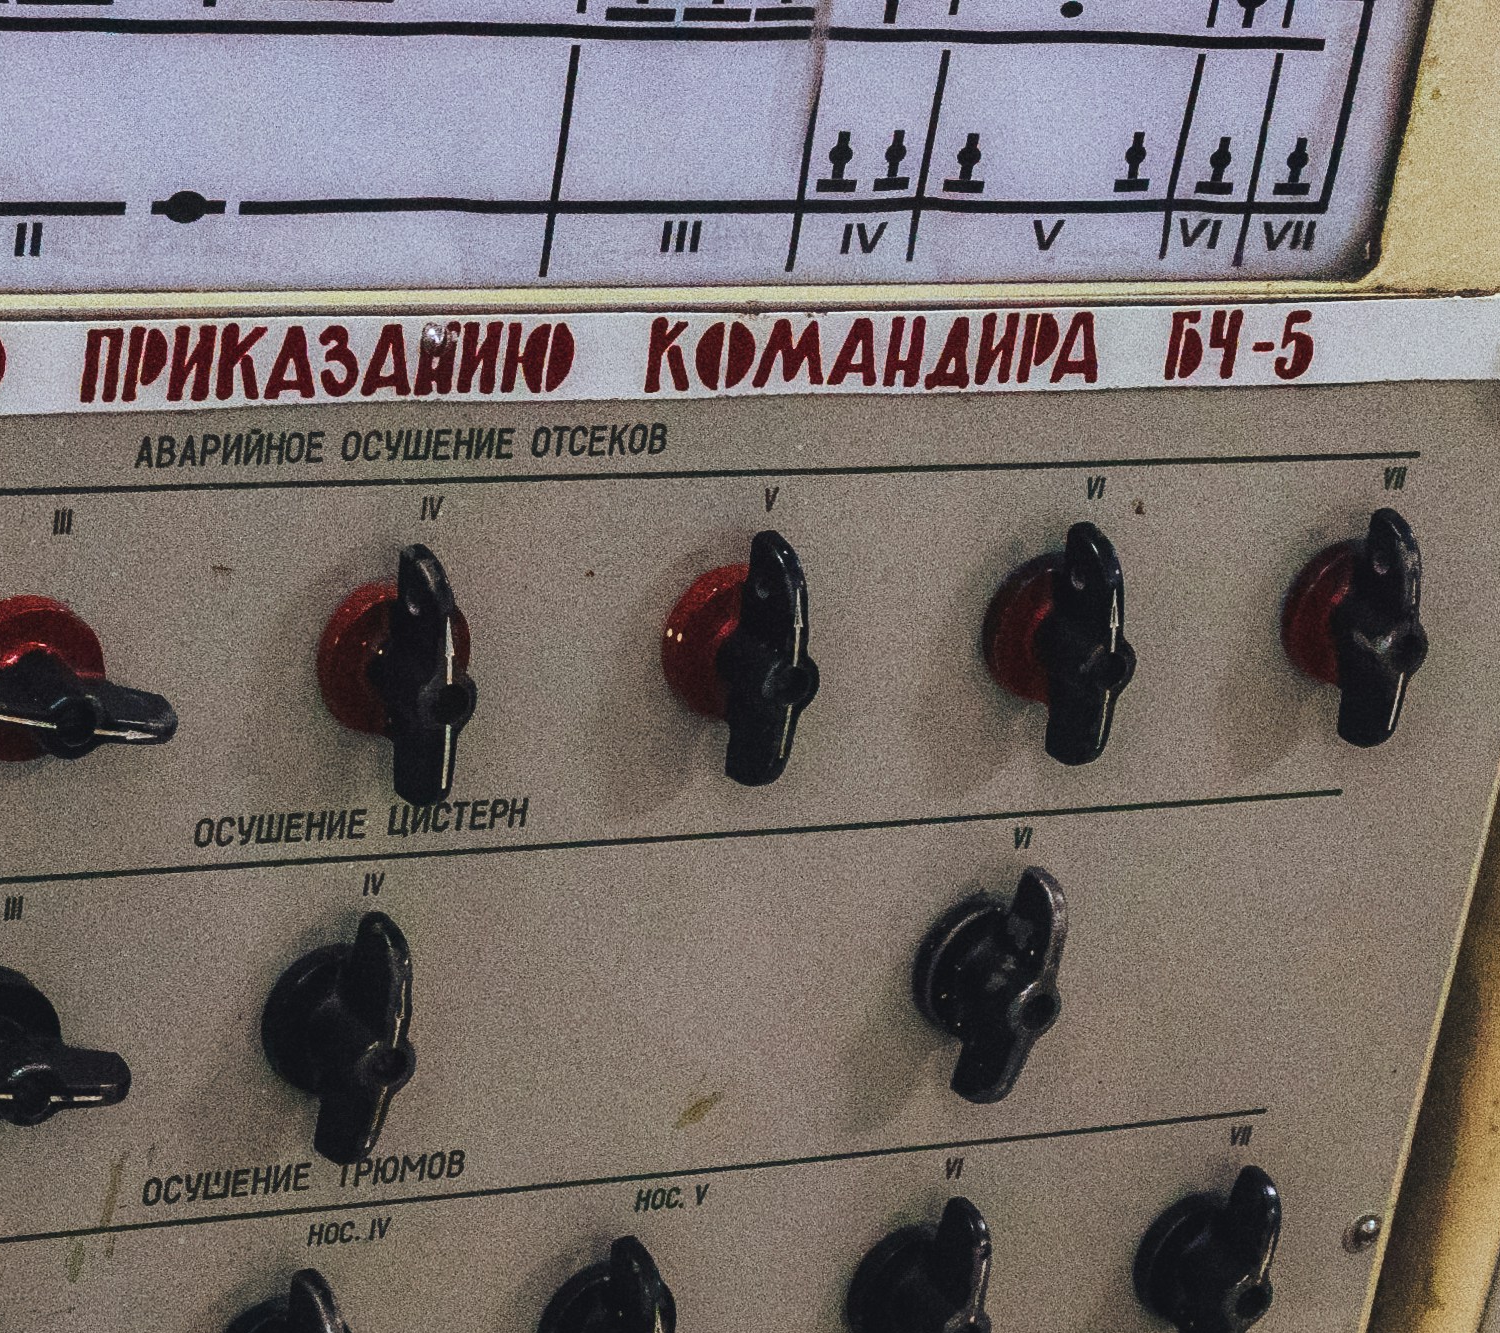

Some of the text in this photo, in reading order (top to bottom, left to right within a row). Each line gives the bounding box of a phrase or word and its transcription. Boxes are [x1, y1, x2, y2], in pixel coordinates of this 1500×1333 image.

[840, 222, 888, 254] IV
[1033, 219, 1065, 251] V
[1179, 219, 1223, 249] VI
[80, 321, 576, 404] ПРИКАЗАНИЮ
[644, 312, 1098, 394] КОМАНДИРА
[1163, 310, 1315, 380] БЧ-5
[134, 423, 669, 469] АВАРИЙНОЕ ОСУШЕНИЕ ОТСЕКОВ
[194, 797, 530, 849] ОСУШЕНИЕ ЦИСТЕРН
[141, 1148, 466, 1207] ОСУШЕНИЕ ТРЮМОВ
[634, 1187, 685, 1213] НОС.
[307, 1221, 362, 1247] НОС.
